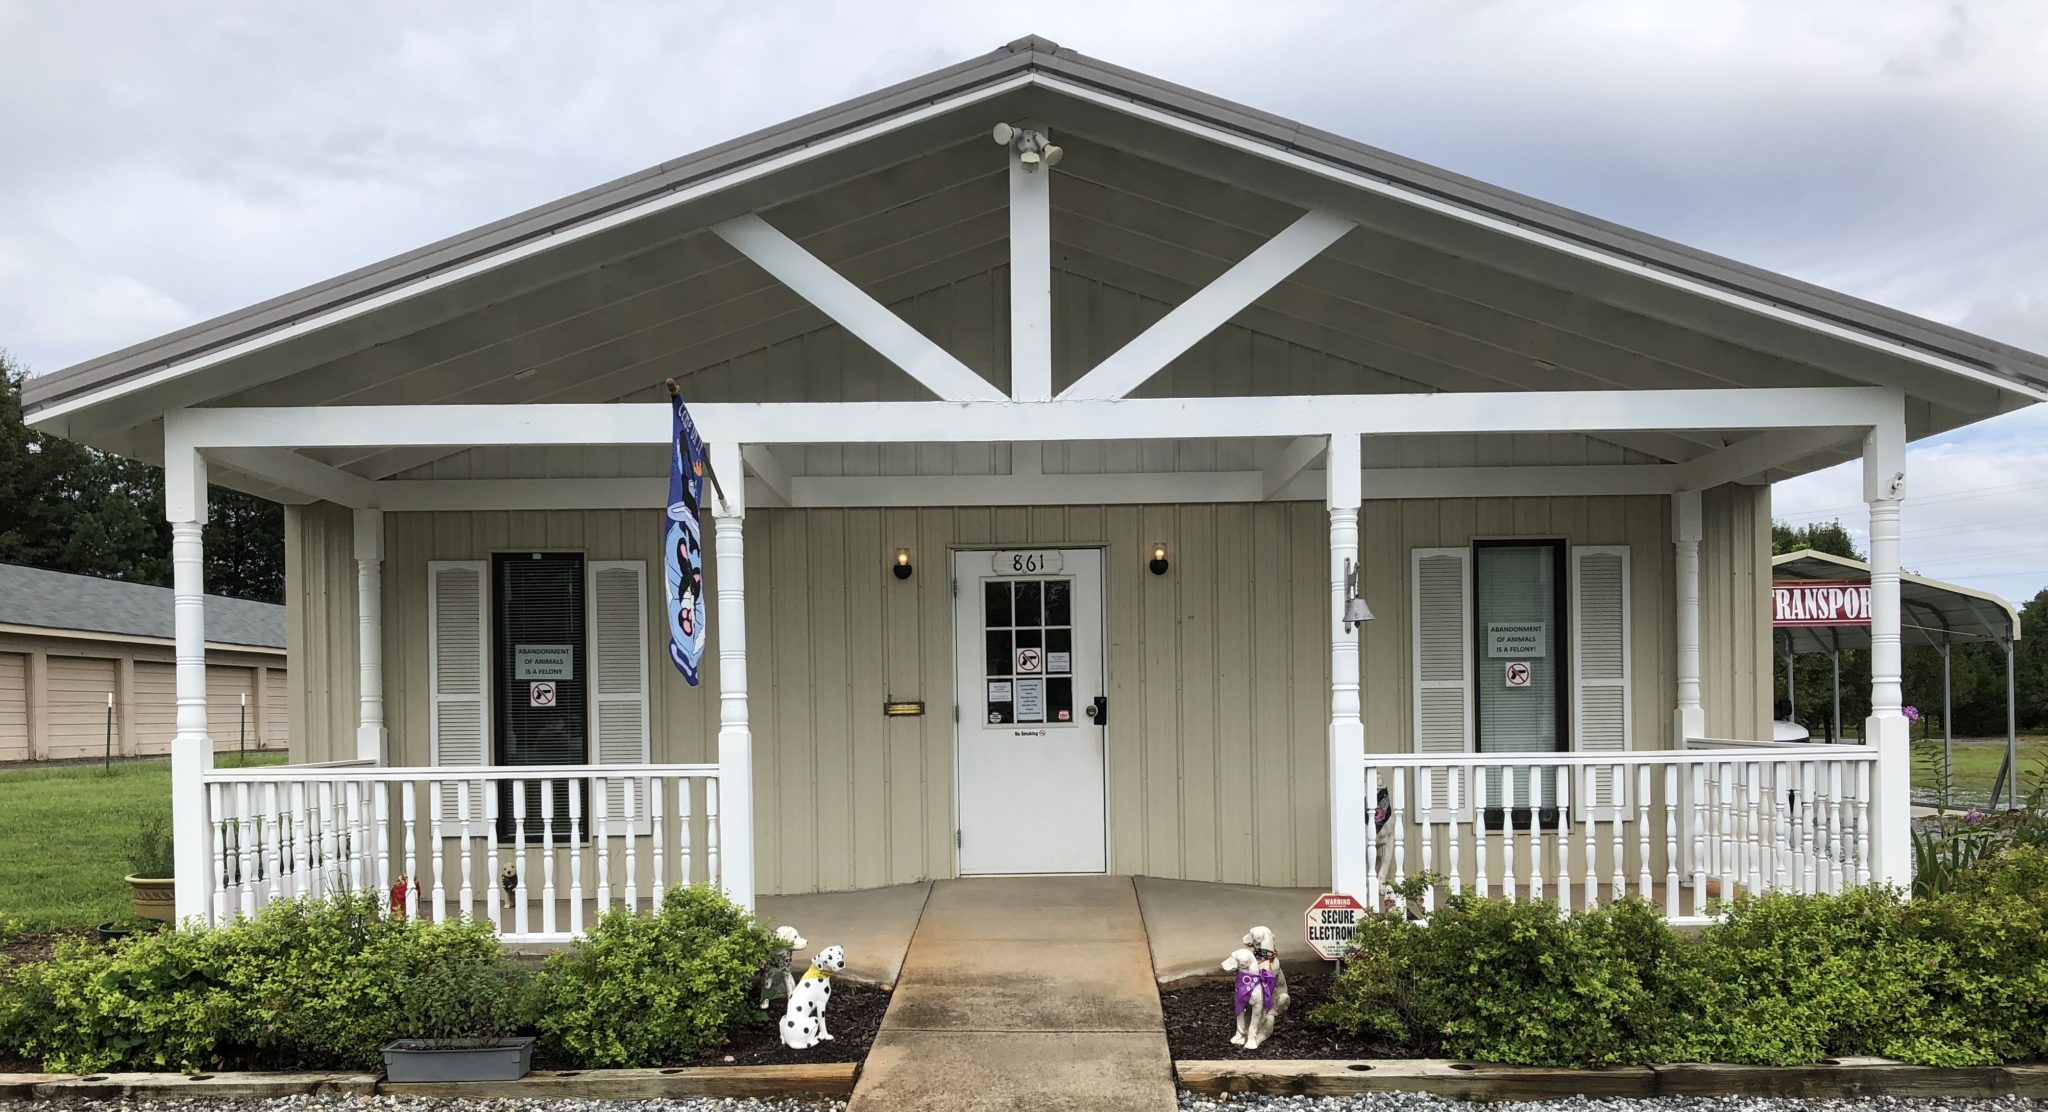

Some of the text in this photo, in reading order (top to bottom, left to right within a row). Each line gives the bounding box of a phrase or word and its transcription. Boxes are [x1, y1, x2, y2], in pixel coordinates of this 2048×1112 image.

[1013, 554, 1044, 571] 861
[1772, 587, 1872, 619] RANSPOR
[1321, 910, 1355, 924] SECURE
